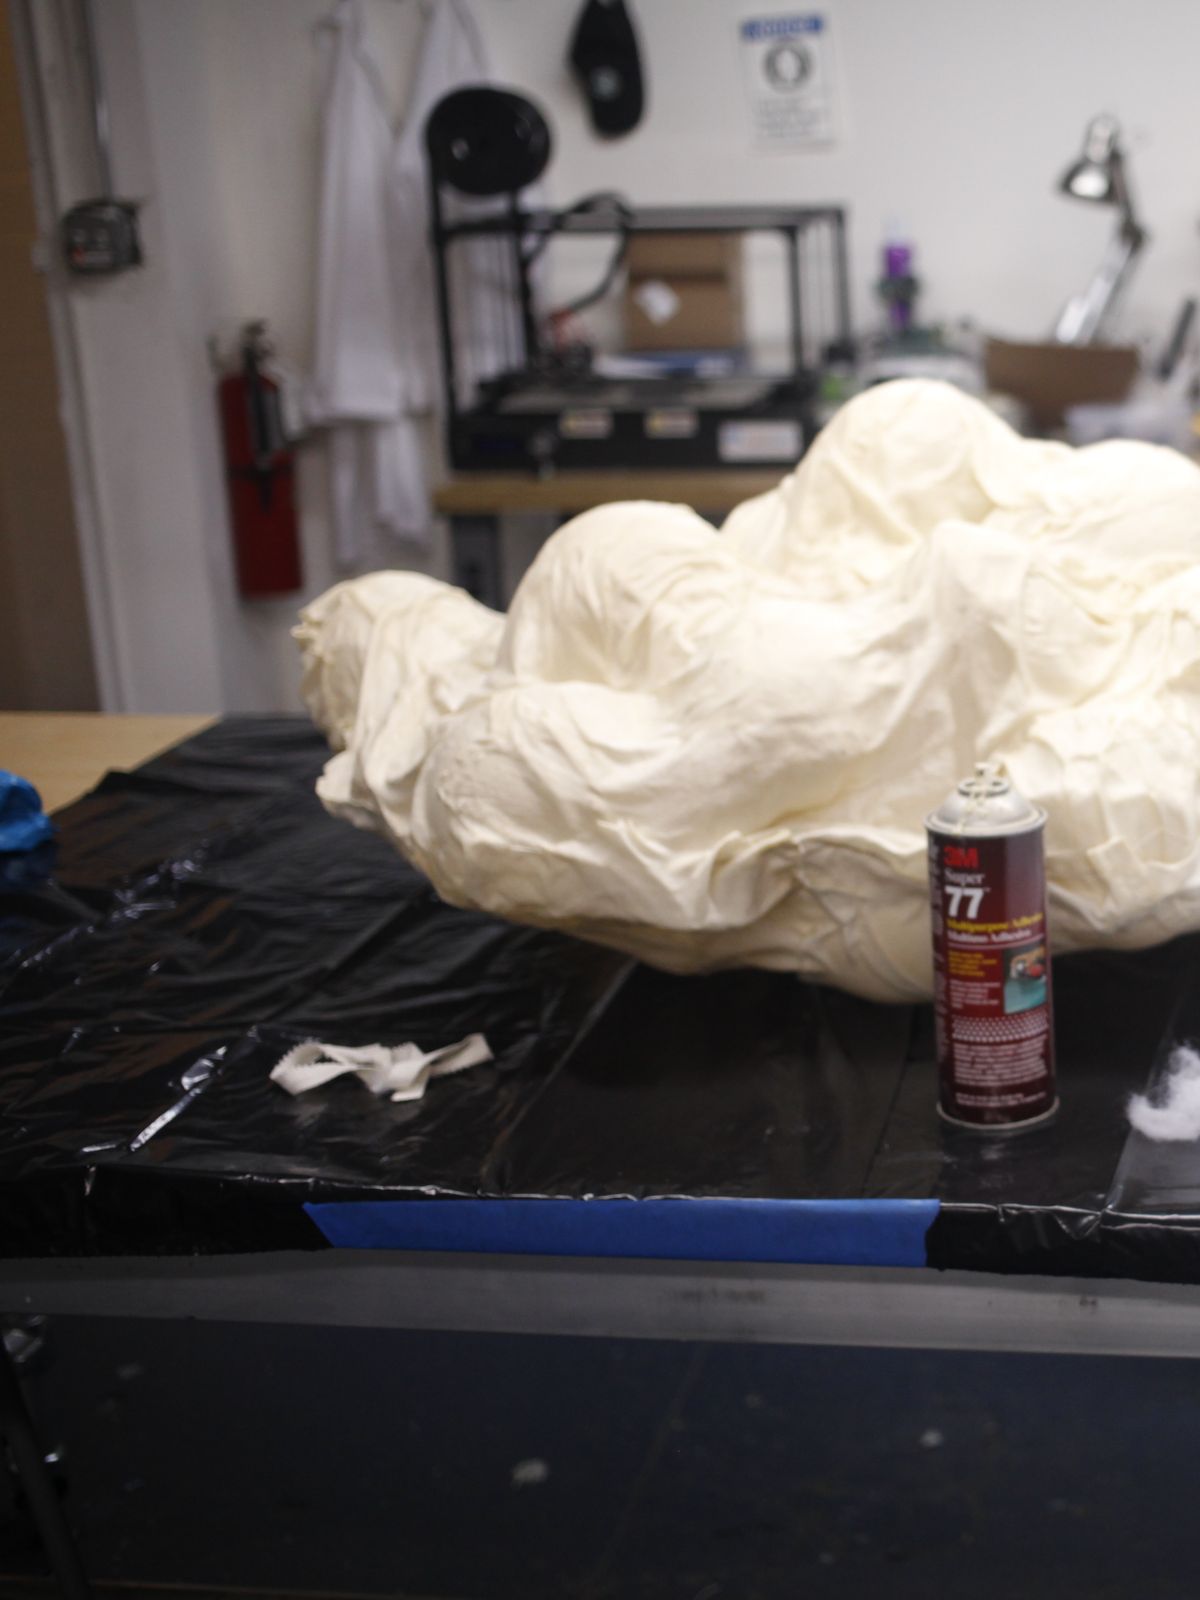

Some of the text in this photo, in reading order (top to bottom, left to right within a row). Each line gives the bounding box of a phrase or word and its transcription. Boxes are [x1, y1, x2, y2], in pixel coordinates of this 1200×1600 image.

[943, 847, 979, 868] 3M
[944, 868, 985, 886] Super
[945, 886, 985, 919] 77
